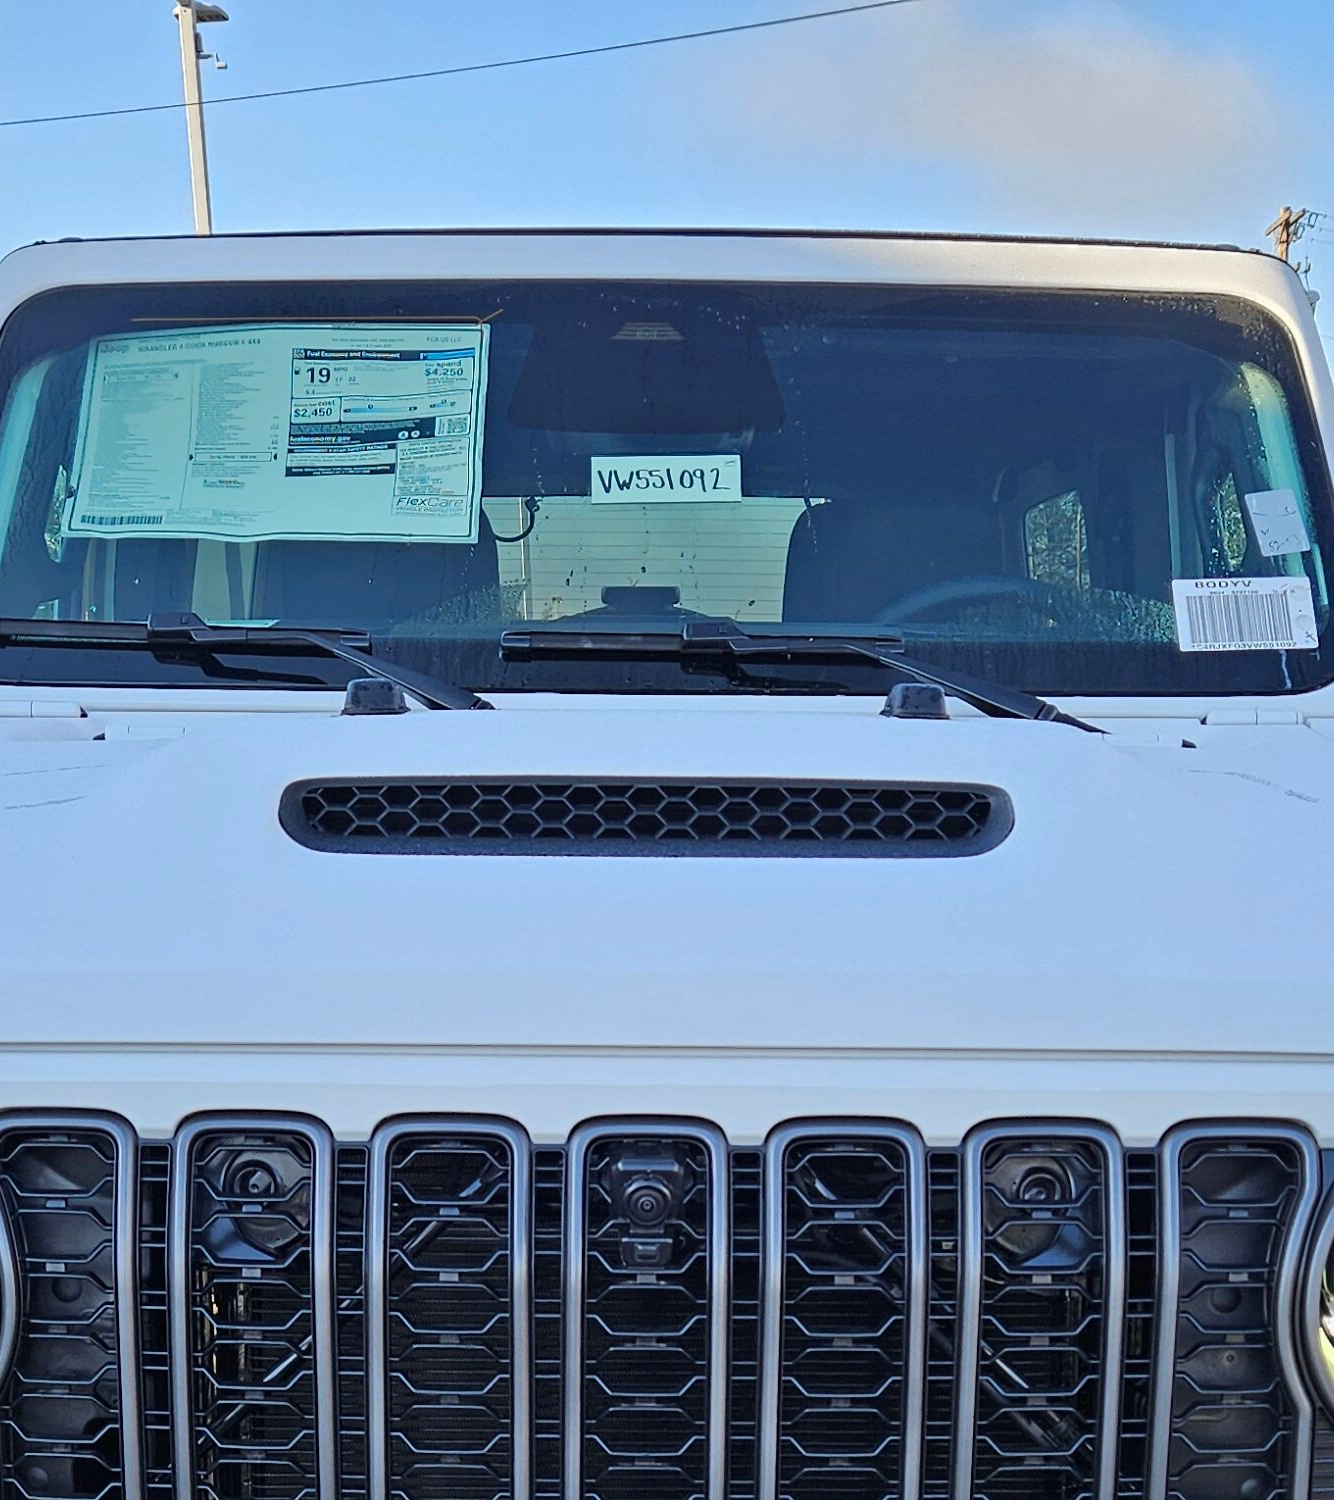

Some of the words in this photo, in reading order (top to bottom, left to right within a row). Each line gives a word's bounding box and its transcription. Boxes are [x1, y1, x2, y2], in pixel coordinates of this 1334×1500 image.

[306, 367, 331, 384] 19
[424, 368, 464, 377] $4,250
[293, 407, 333, 419] $2,450
[596, 467, 732, 495] VW551092
[395, 496, 464, 507] FlexCare
